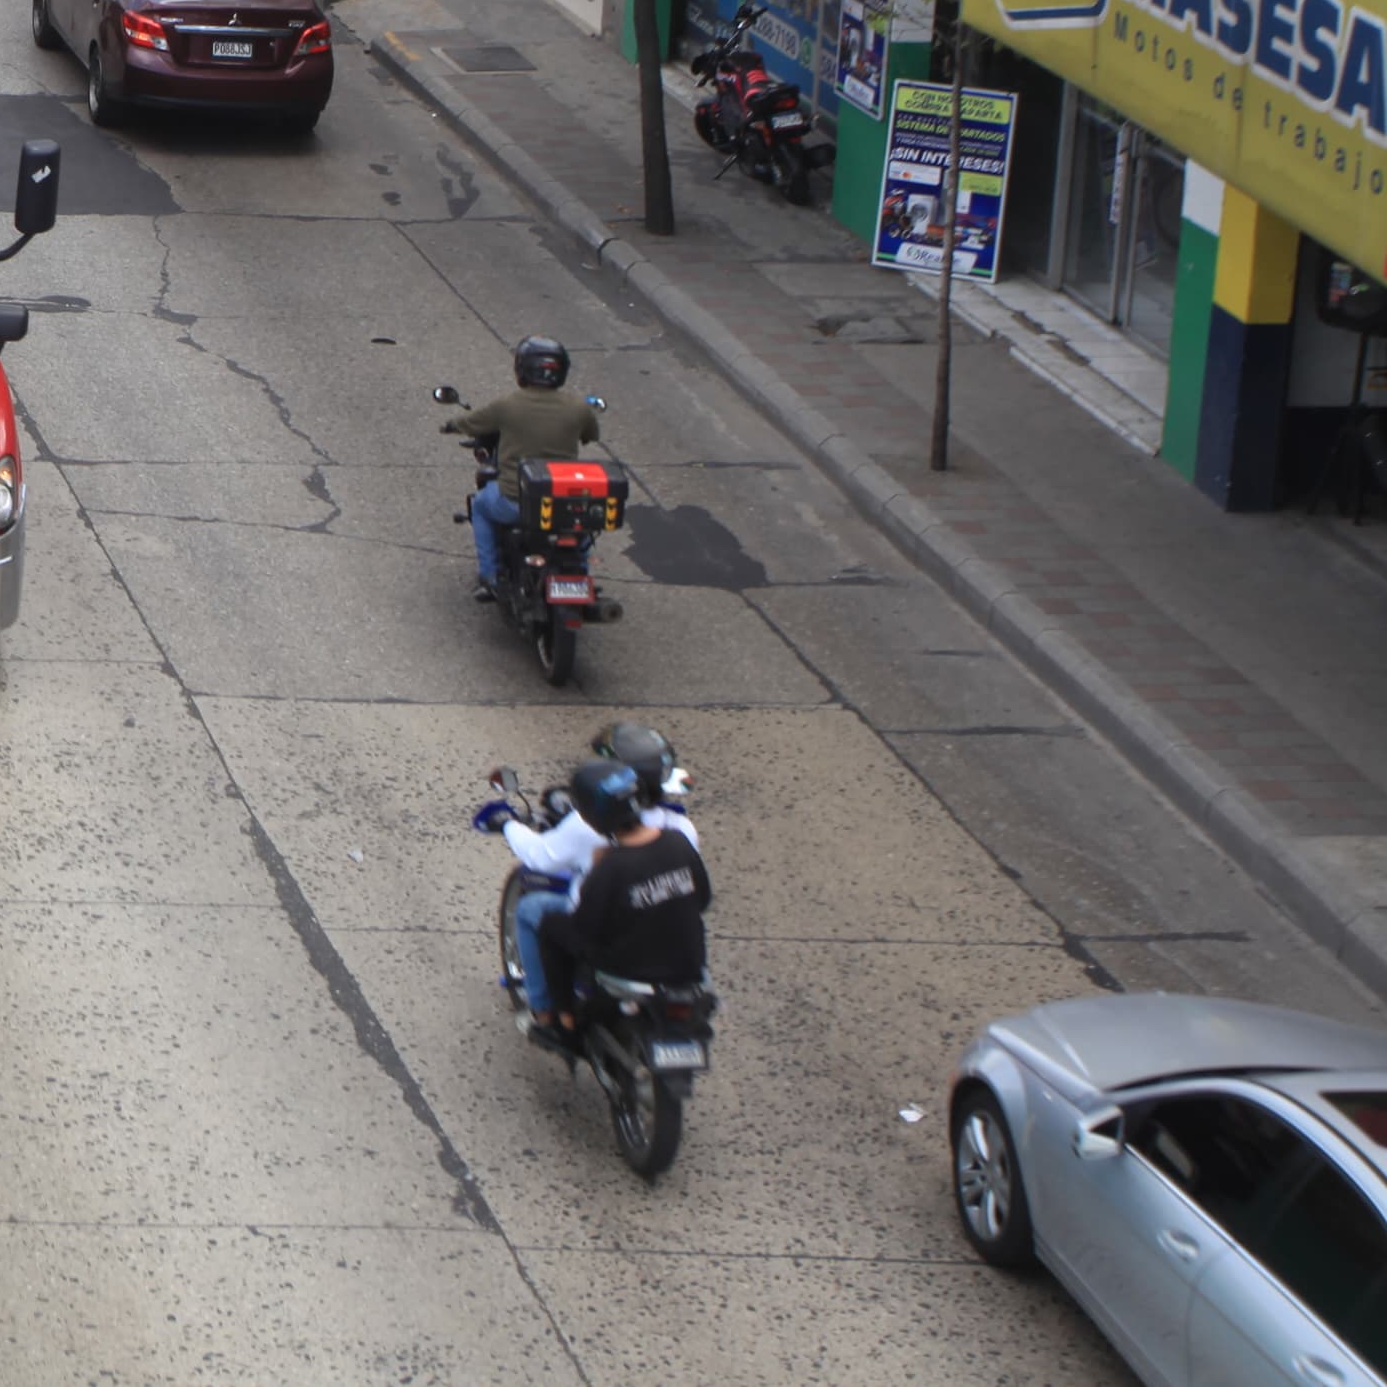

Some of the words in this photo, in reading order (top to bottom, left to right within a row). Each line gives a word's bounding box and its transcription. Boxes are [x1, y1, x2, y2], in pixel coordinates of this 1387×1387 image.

[938, 94, 994, 110] NOOTROS
[1113, 12, 1194, 82] Motos
[1263, 100, 1385, 195] trabajo
